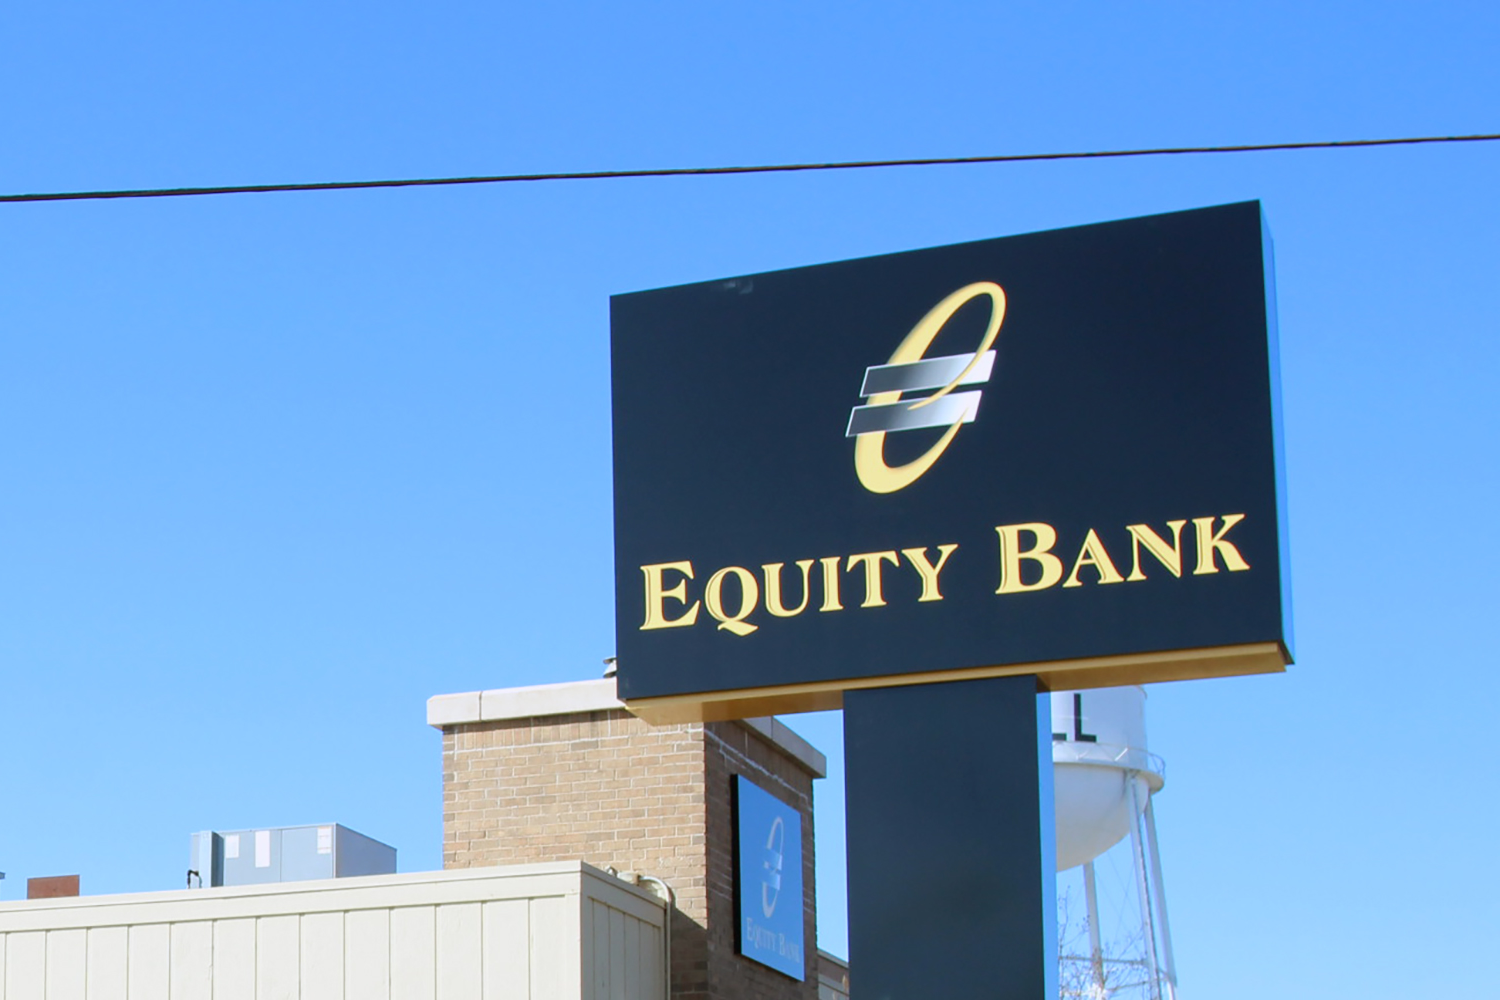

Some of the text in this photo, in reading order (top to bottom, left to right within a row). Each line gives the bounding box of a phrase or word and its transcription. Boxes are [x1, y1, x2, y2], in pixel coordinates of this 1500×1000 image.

[639, 513, 1250, 636] EQUITY BANK
[746, 916, 800, 963] EQUITY BANK
